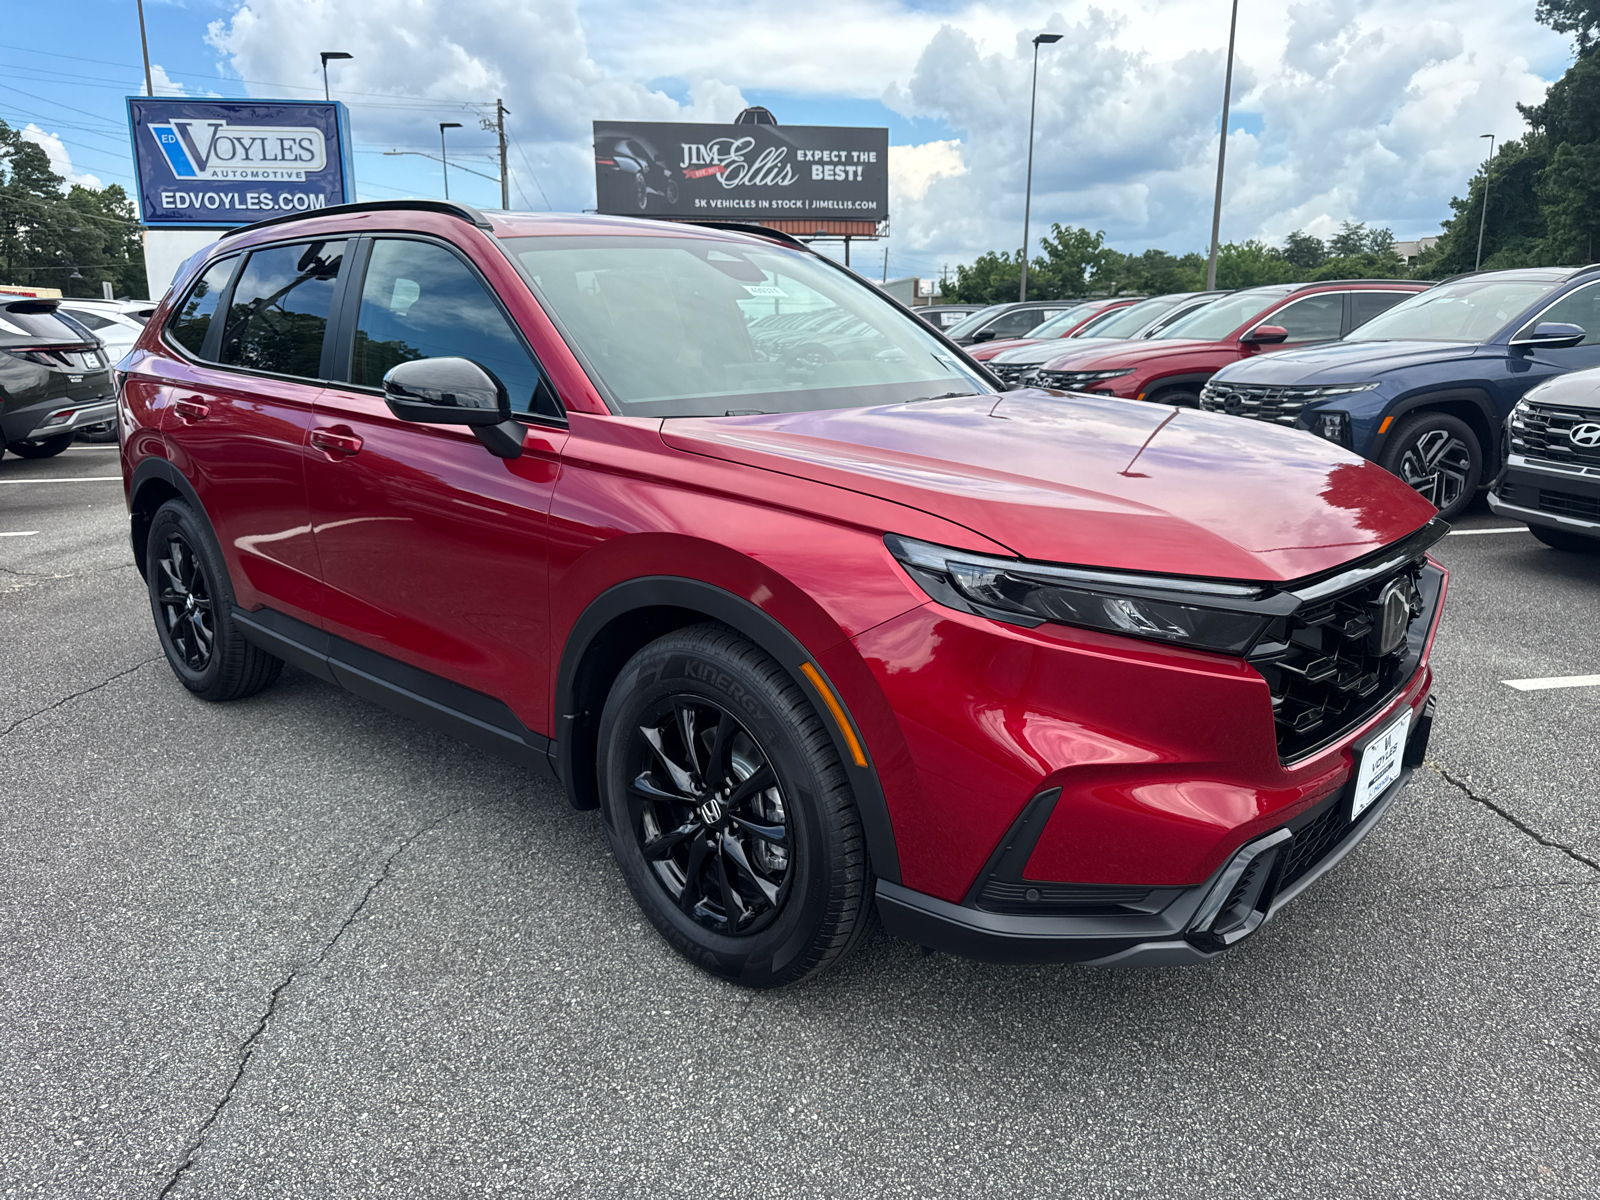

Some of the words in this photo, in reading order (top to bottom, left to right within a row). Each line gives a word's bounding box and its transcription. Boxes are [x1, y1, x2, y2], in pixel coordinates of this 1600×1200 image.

[162, 134, 176, 144] ED
[174, 122, 315, 172] VOYLES
[680, 143, 720, 168] JIM
[707, 136, 799, 189] Ellis
[796, 150, 849, 162] EXPECT
[851, 151, 877, 163] THE
[211, 170, 303, 179] AUTOMOTIVE
[811, 164, 863, 181] BEST!
[161, 192, 326, 210] EDVOYLES.COM
[694, 198, 708, 208] 5K
[710, 199, 756, 209] VEHICLES
[758, 199, 770, 208] IN
[771, 200, 803, 209] STOCK
[811, 200, 877, 210] JIMELLIS.COM
[684, 659, 770, 720] KINERGY
